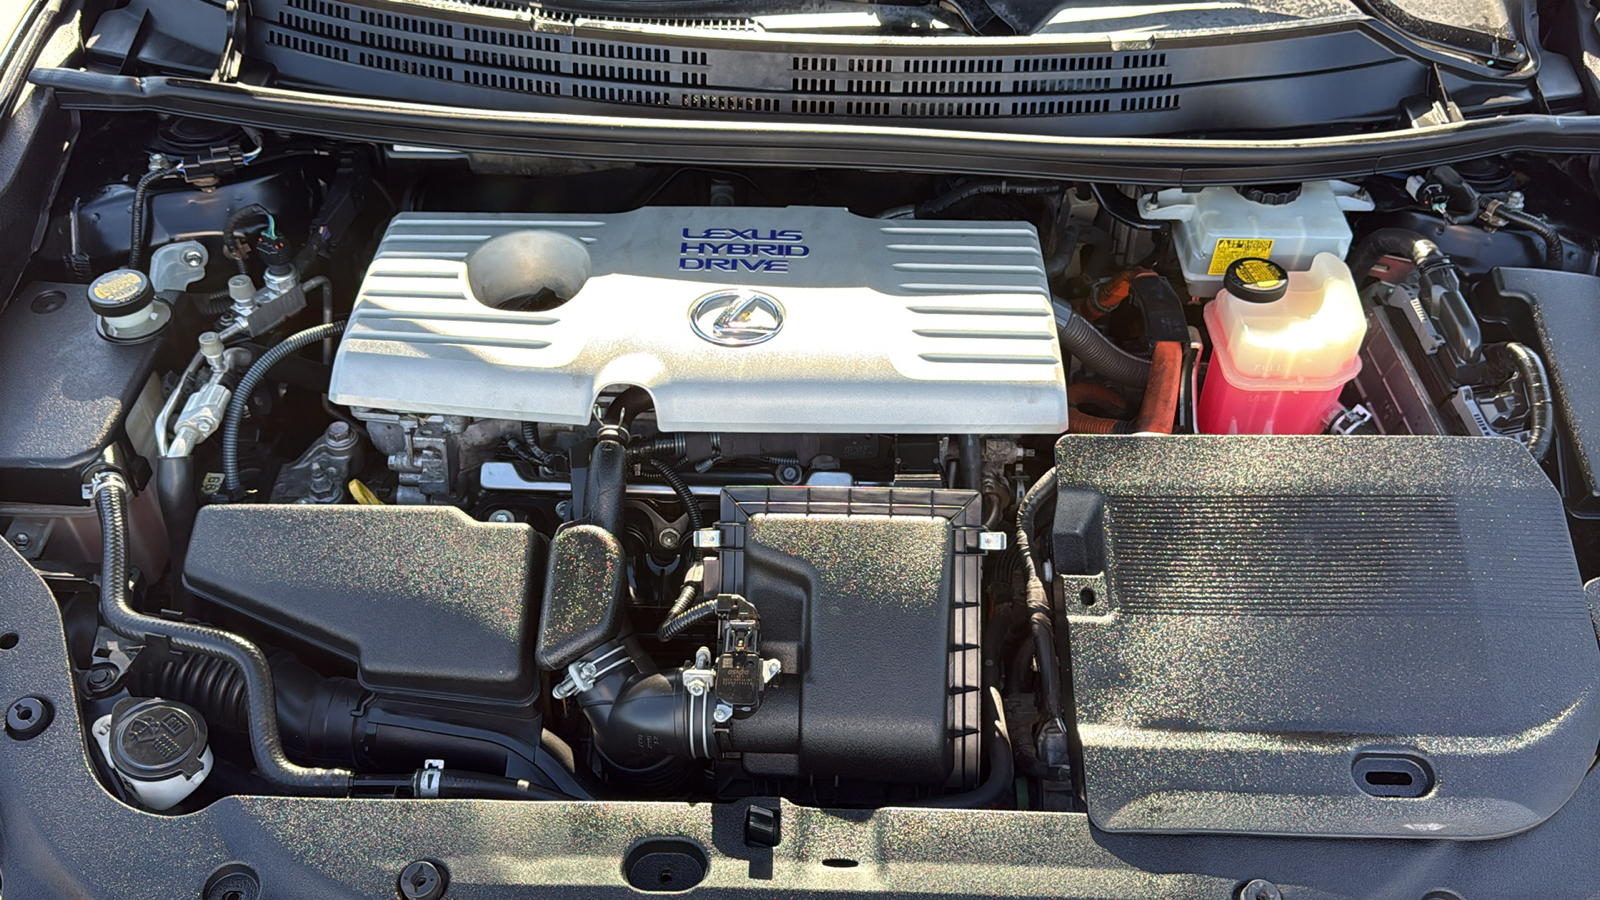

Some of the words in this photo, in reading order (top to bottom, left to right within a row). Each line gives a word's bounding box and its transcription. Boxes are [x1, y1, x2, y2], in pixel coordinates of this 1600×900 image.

[682, 228, 803, 242] LEXUS
[680, 243, 809, 258] HYBRID
[679, 258, 789, 273] DRIVE
